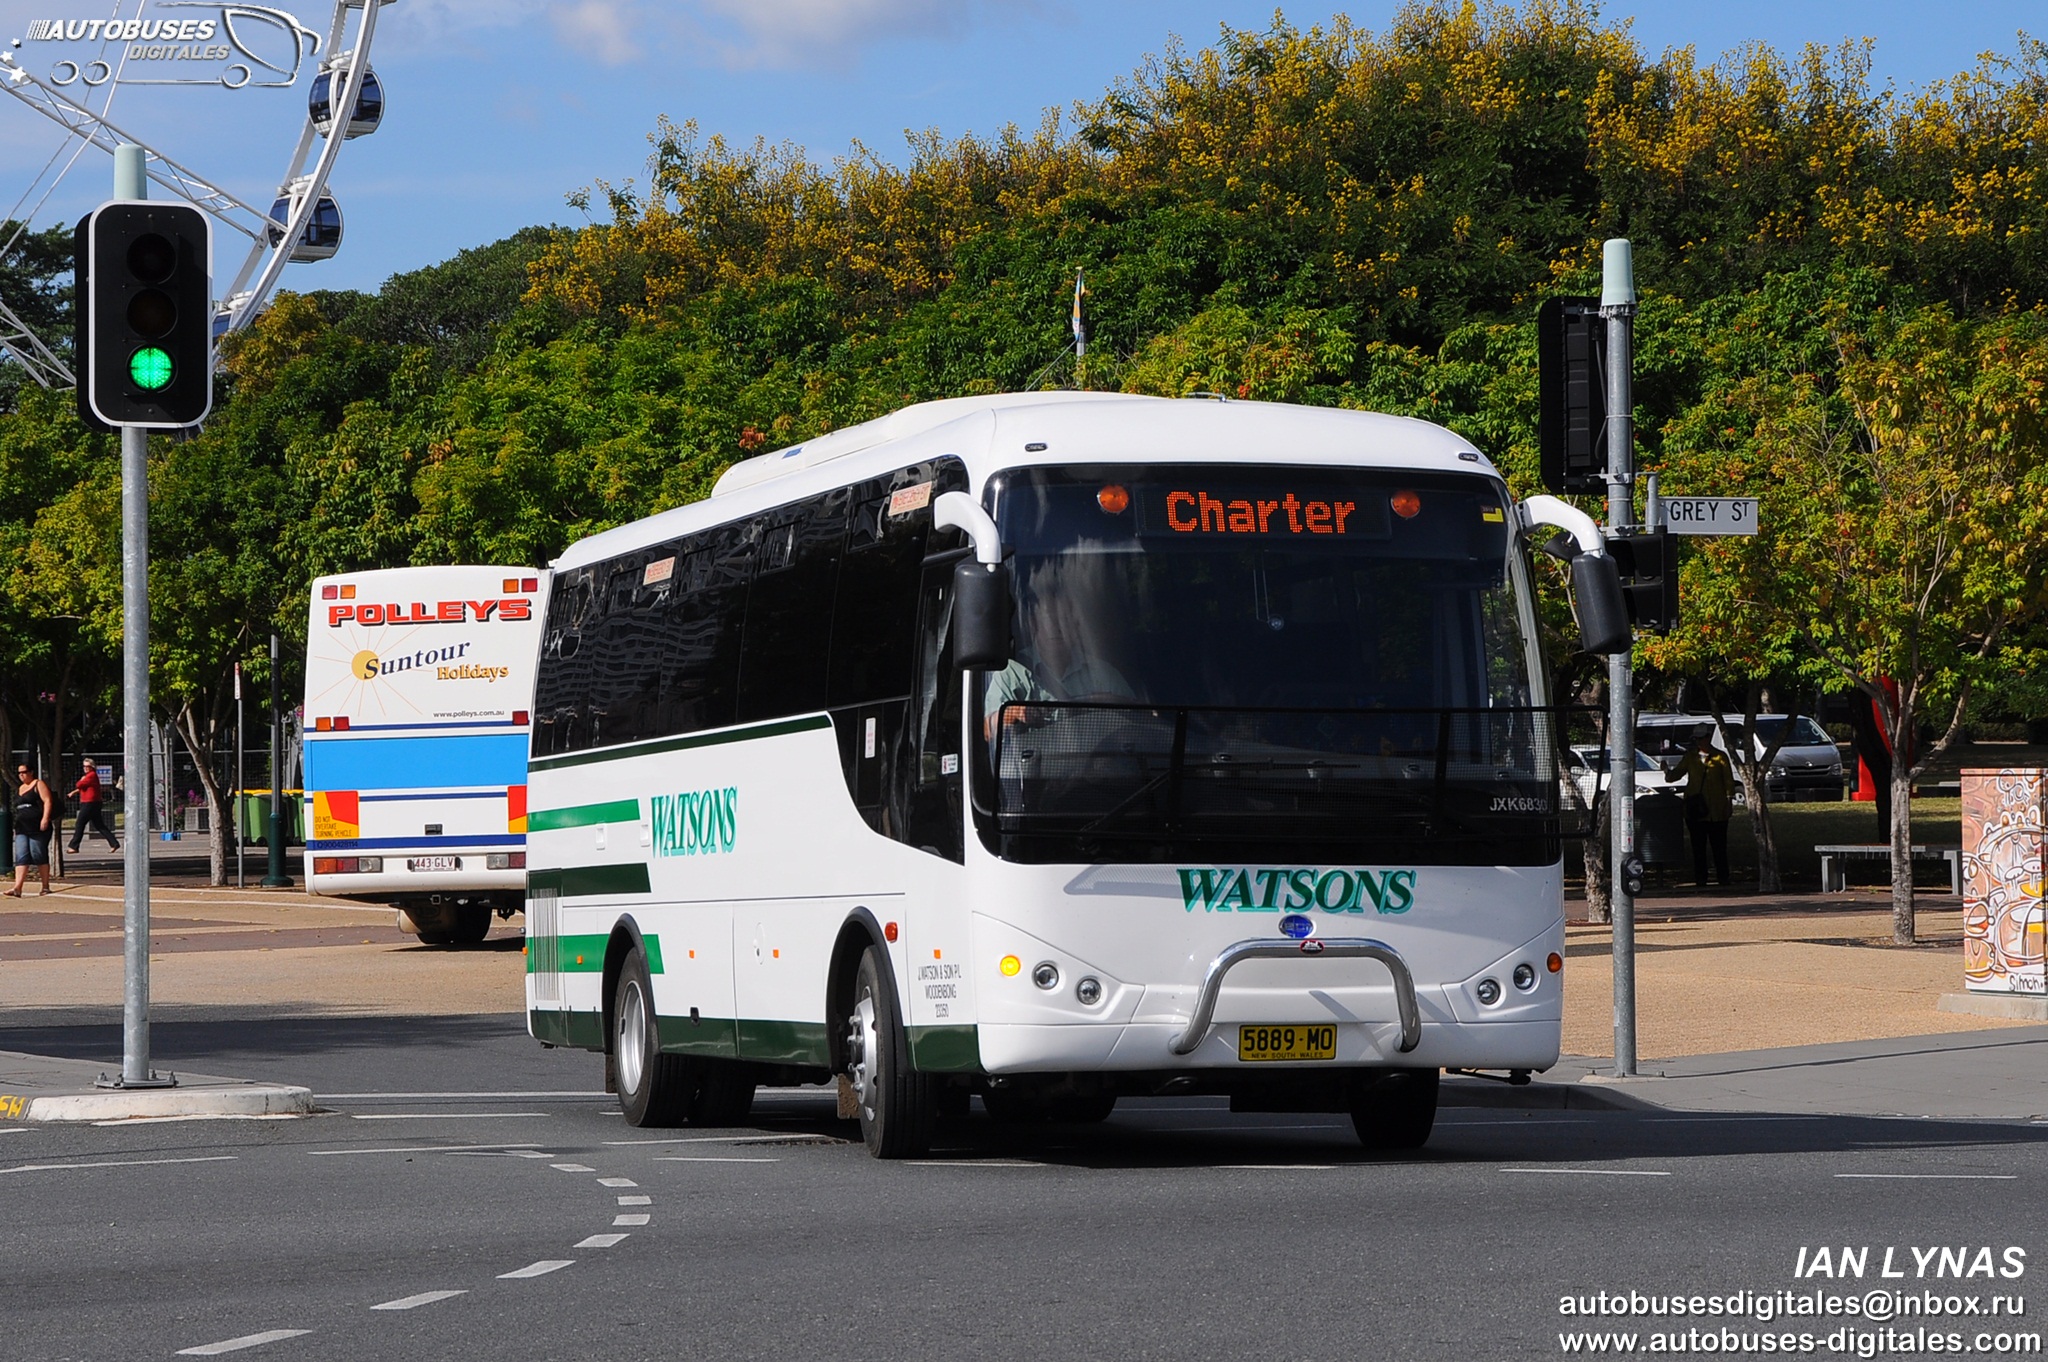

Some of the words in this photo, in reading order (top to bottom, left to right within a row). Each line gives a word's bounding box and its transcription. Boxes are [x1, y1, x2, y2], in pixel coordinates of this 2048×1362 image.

[1166, 491, 1356, 534] Charter
[1670, 501, 1719, 521] GREY
[1731, 502, 1749, 521] ST
[328, 599, 532, 627] POLLEYS
[363, 641, 470, 680] Suntour
[437, 664, 509, 683] Holidays
[433, 710, 505, 719] www.polleys.com.au
[650, 786, 738, 859] WATSONS
[1176, 868, 1417, 914] WATSONS
